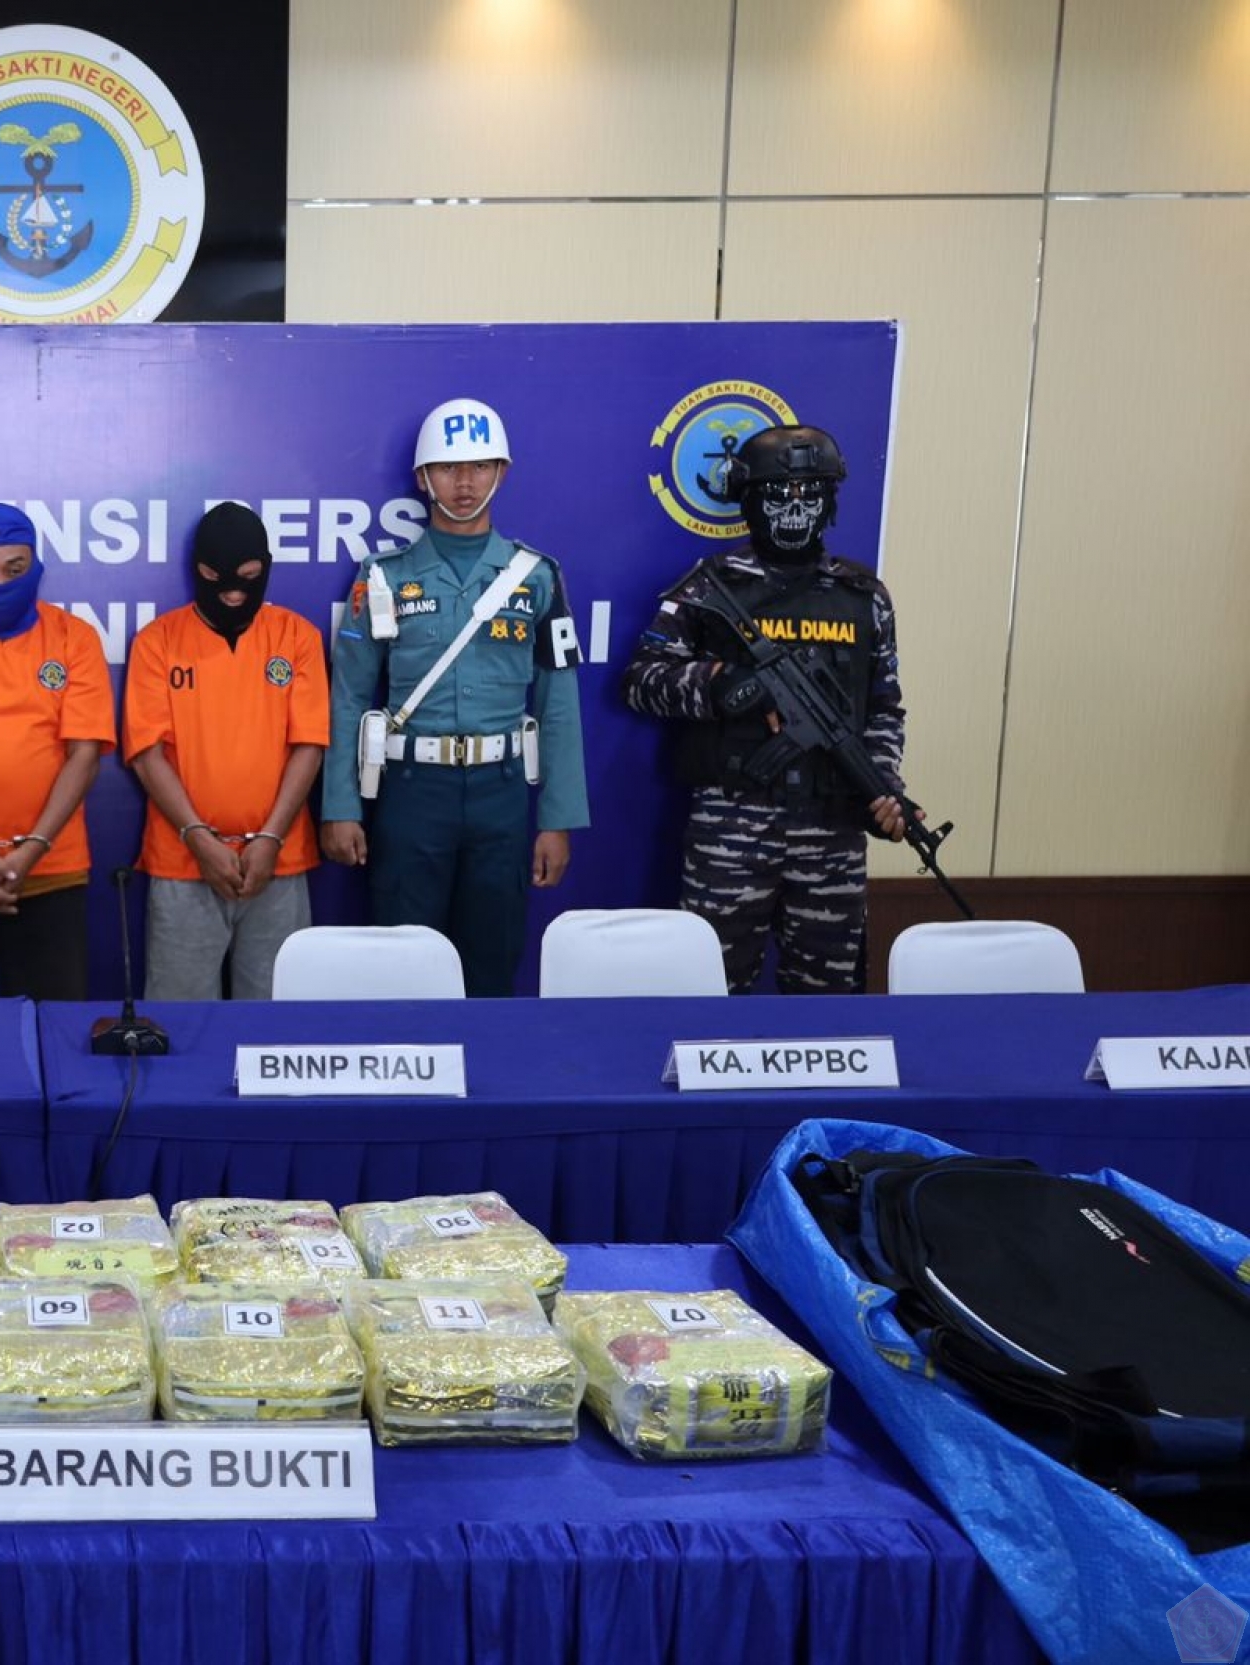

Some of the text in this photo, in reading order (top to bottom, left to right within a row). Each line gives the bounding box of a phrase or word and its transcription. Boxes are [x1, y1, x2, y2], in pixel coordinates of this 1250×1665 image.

[69, 62, 149, 123] NEGERI
[707, 383, 744, 396] SAKTI
[443, 413, 490, 446] PM
[204, 498, 427, 563] ERS
[725, 523, 751, 535] DUM
[397, 599, 437, 615] AMBANG
[513, 597, 534, 613] AL
[800, 619, 855, 643] DUMAI
[169, 666, 195, 690] 01
[259, 1054, 436, 1081] BNNP RIAU
[699, 1050, 869, 1074] KA. KPPBC
[435, 1215, 471, 1229] 06
[311, 1244, 348, 1258] 01
[40, 1300, 78, 1314] 09
[434, 1304, 474, 1319] 11
[236, 1311, 273, 1326] 10
[209, 1450, 351, 1488] BUKTI
